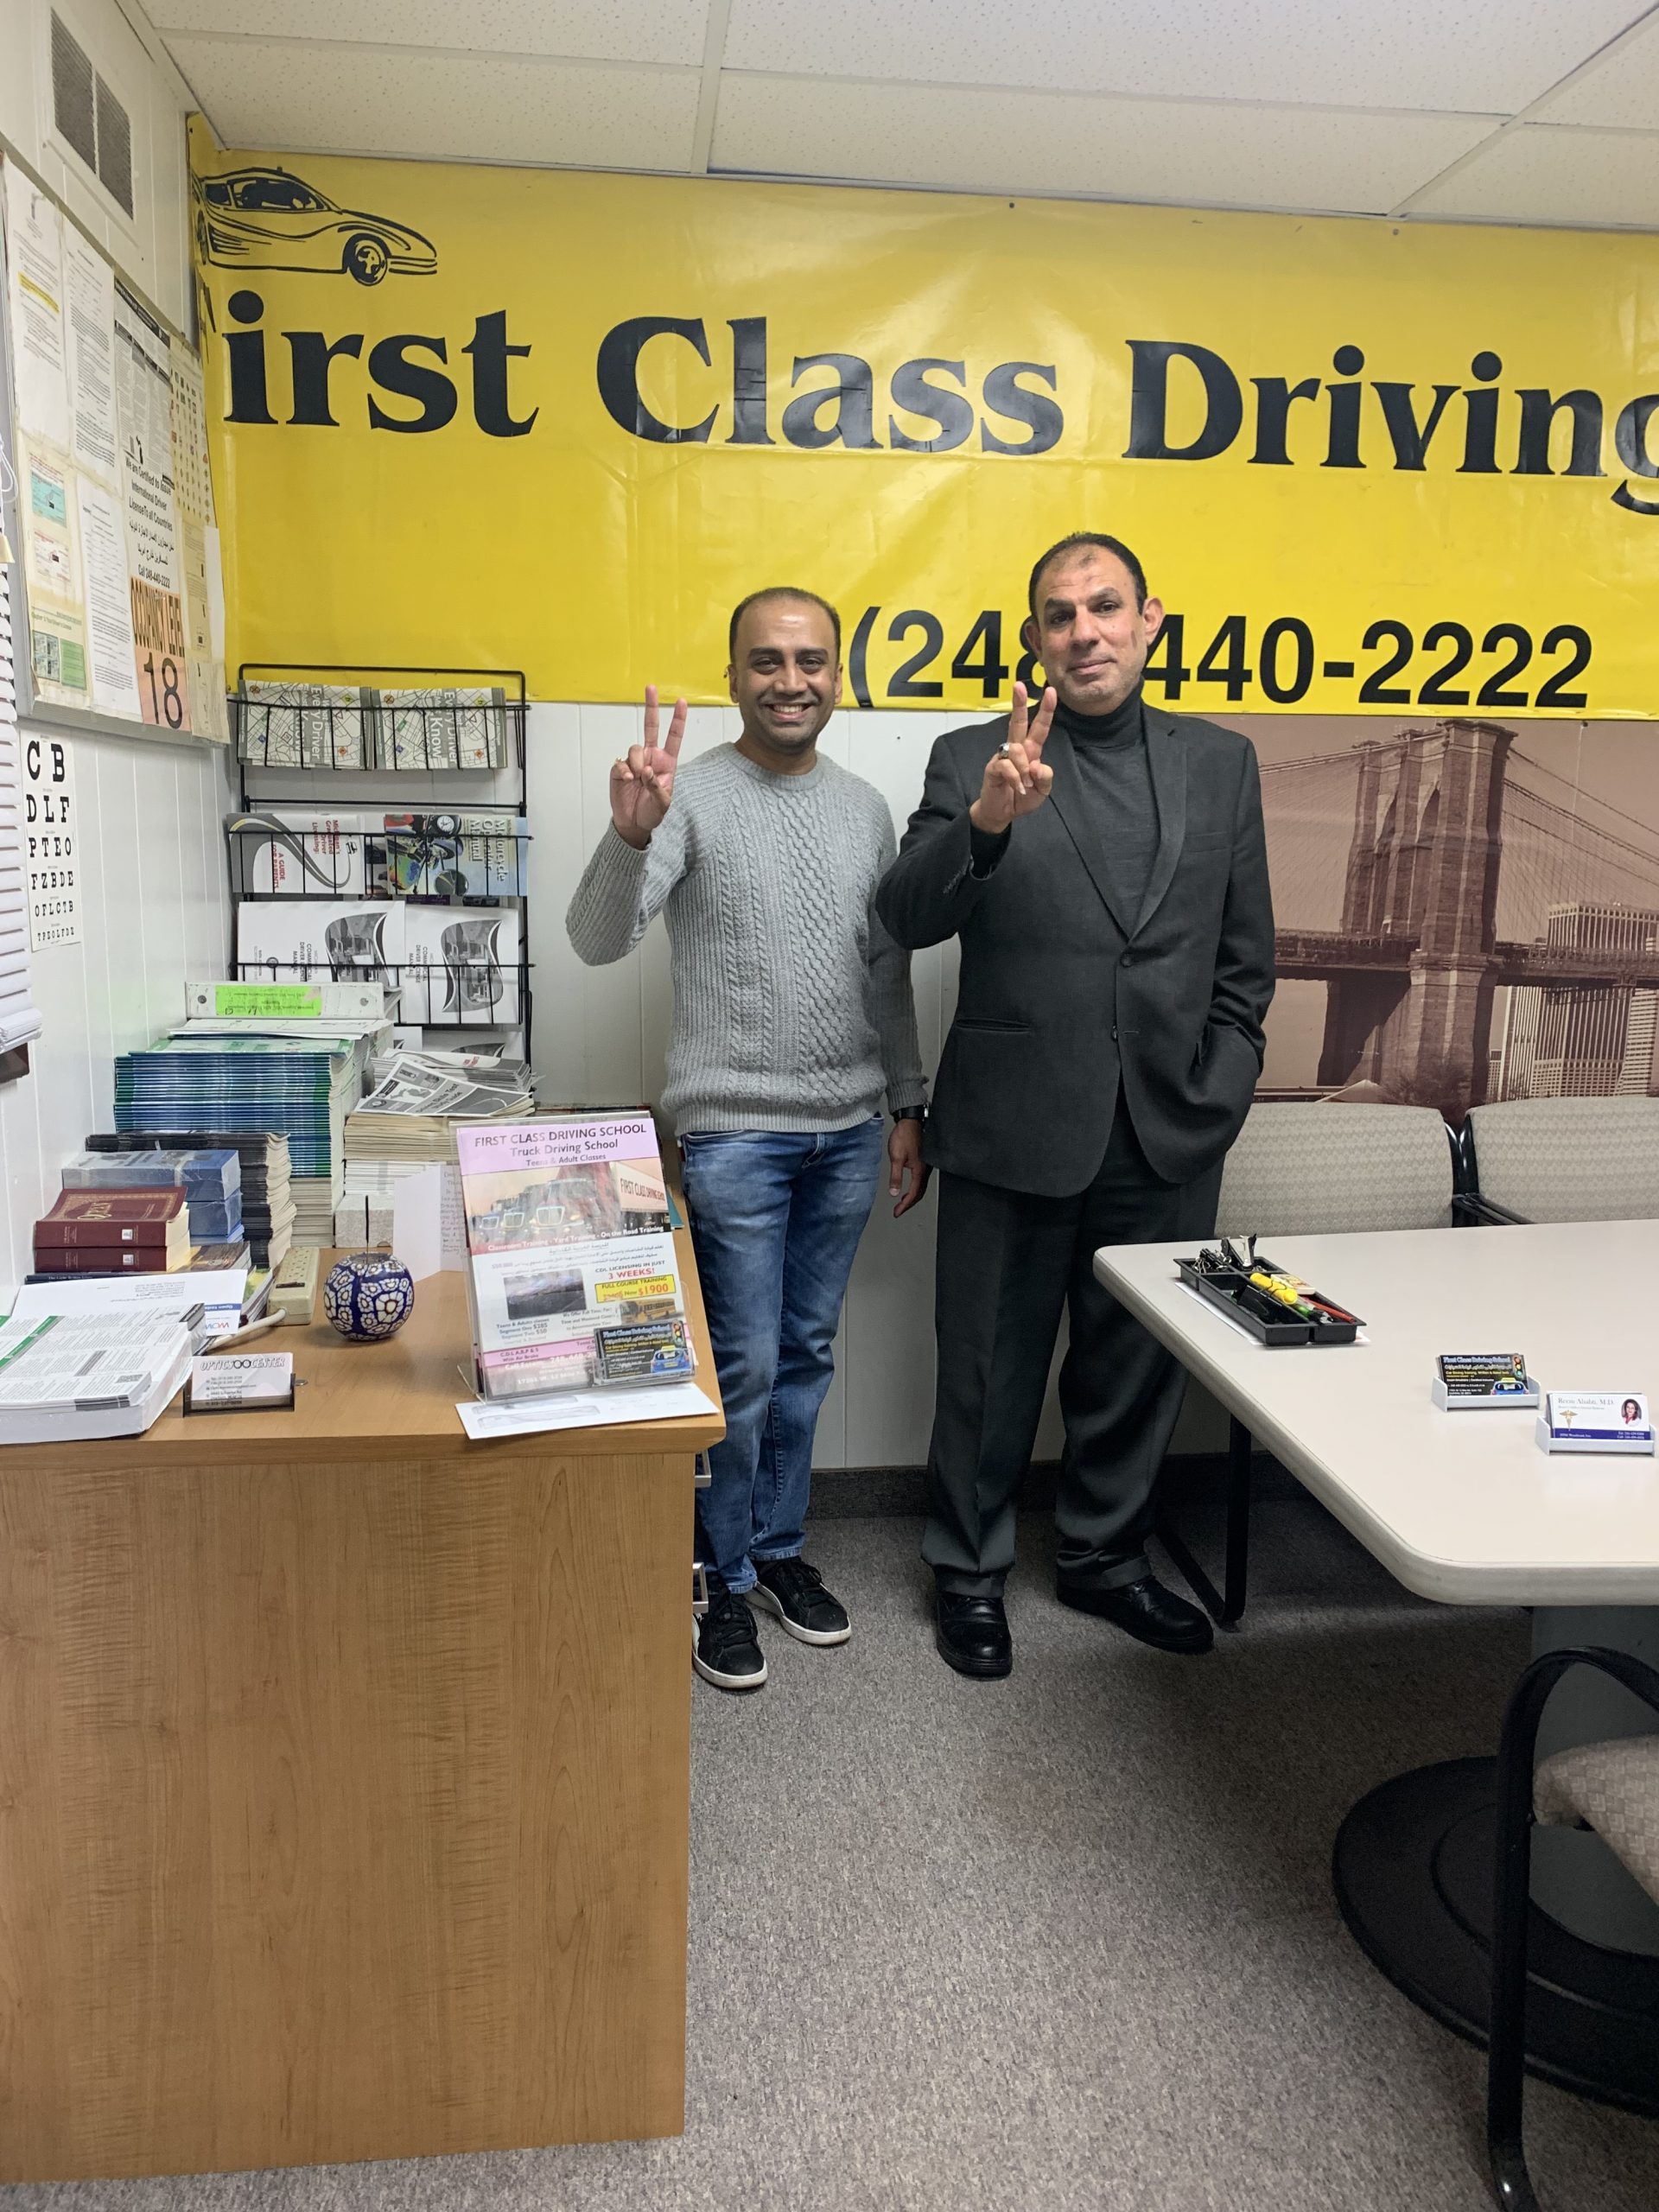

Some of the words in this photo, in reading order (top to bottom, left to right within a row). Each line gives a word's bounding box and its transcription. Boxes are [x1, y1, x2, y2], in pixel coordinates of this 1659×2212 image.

[200, 289, 539, 437] irst
[596, 315, 1065, 455] Class
[155, 493, 167, 512] Driver
[1143, 613, 1592, 709] 440-2222
[143, 652, 182, 729] 18
[310, 687, 322, 720] Evey
[444, 691, 455, 724] Evry
[311, 721, 323, 760] Driver
[430, 717, 443, 759] Know
[447, 728, 458, 764] Driver
[312, 822, 321, 855] Licnsing:
[325, 820, 334, 855] Grauated
[333, 820, 341, 855] Michgan's
[475, 1135, 507, 1147] FIRST
[511, 1132, 546, 1144] CLASS
[549, 1128, 596, 1141] DRIVING
[599, 1123, 647, 1136] SCHOOL
[510, 1146, 541, 1157] Truck
[544, 1142, 582, 1154] Driving
[585, 1139, 618, 1151] School
[558, 1155, 578, 1164] Adult
[620, 1178, 633, 1195] FIRST
[487, 1242, 522, 1251] Classroom
[523, 1238, 549, 1248] Training
[553, 1235, 569, 1243] Yard
[570, 1233, 596, 1243] Training
[623, 1227, 638, 1236] Road
[639, 1225, 664, 1235] Training
[616, 1268, 655, 1279] WEEKS!
[638, 1283, 669, 1296] $1900
